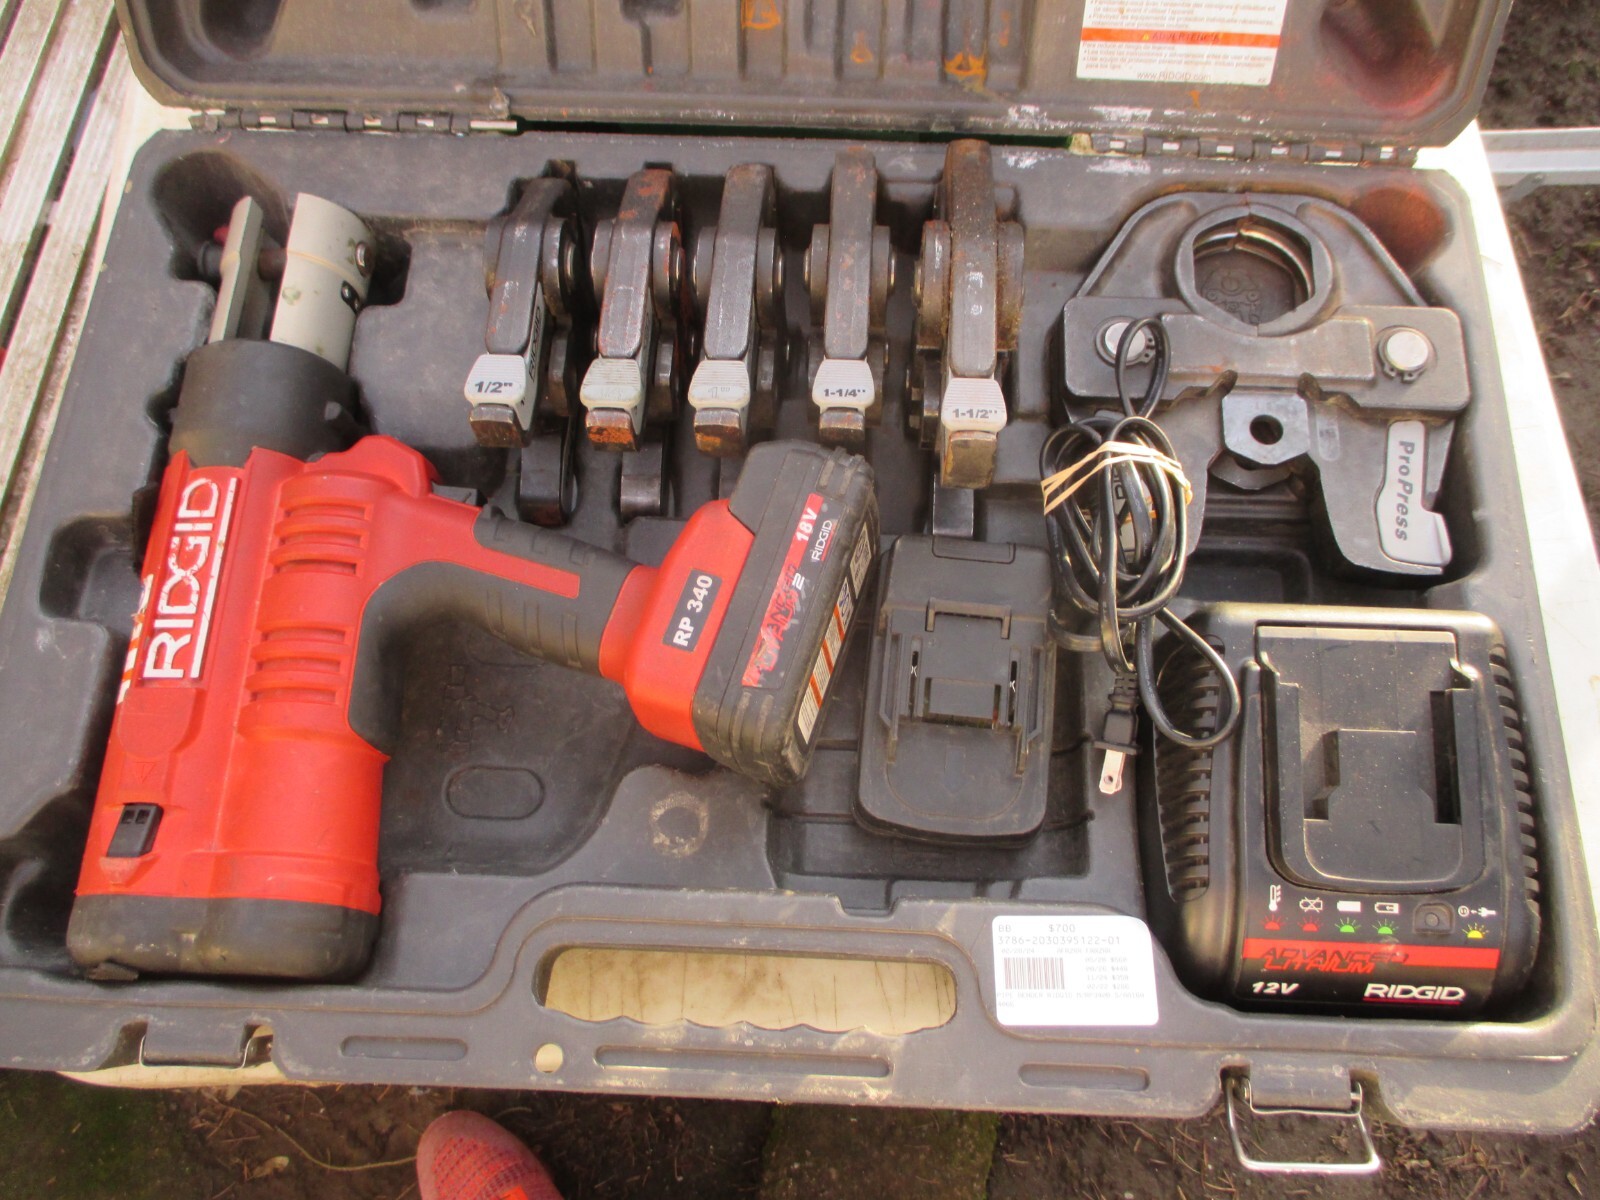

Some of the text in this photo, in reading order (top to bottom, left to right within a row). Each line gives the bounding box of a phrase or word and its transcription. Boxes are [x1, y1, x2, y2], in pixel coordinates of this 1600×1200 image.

[474, 381, 513, 394] 1/2"
[1394, 440, 1415, 541] ProPress
[797, 507, 818, 541] 18V
[811, 519, 833, 562] RIDGID
[142, 477, 220, 678] RIDGID
[673, 574, 713, 647] RP 340
[1049, 924, 1076, 933] $700
[1252, 981, 1300, 995] 12V
[1363, 983, 1467, 1001] RIDGID
